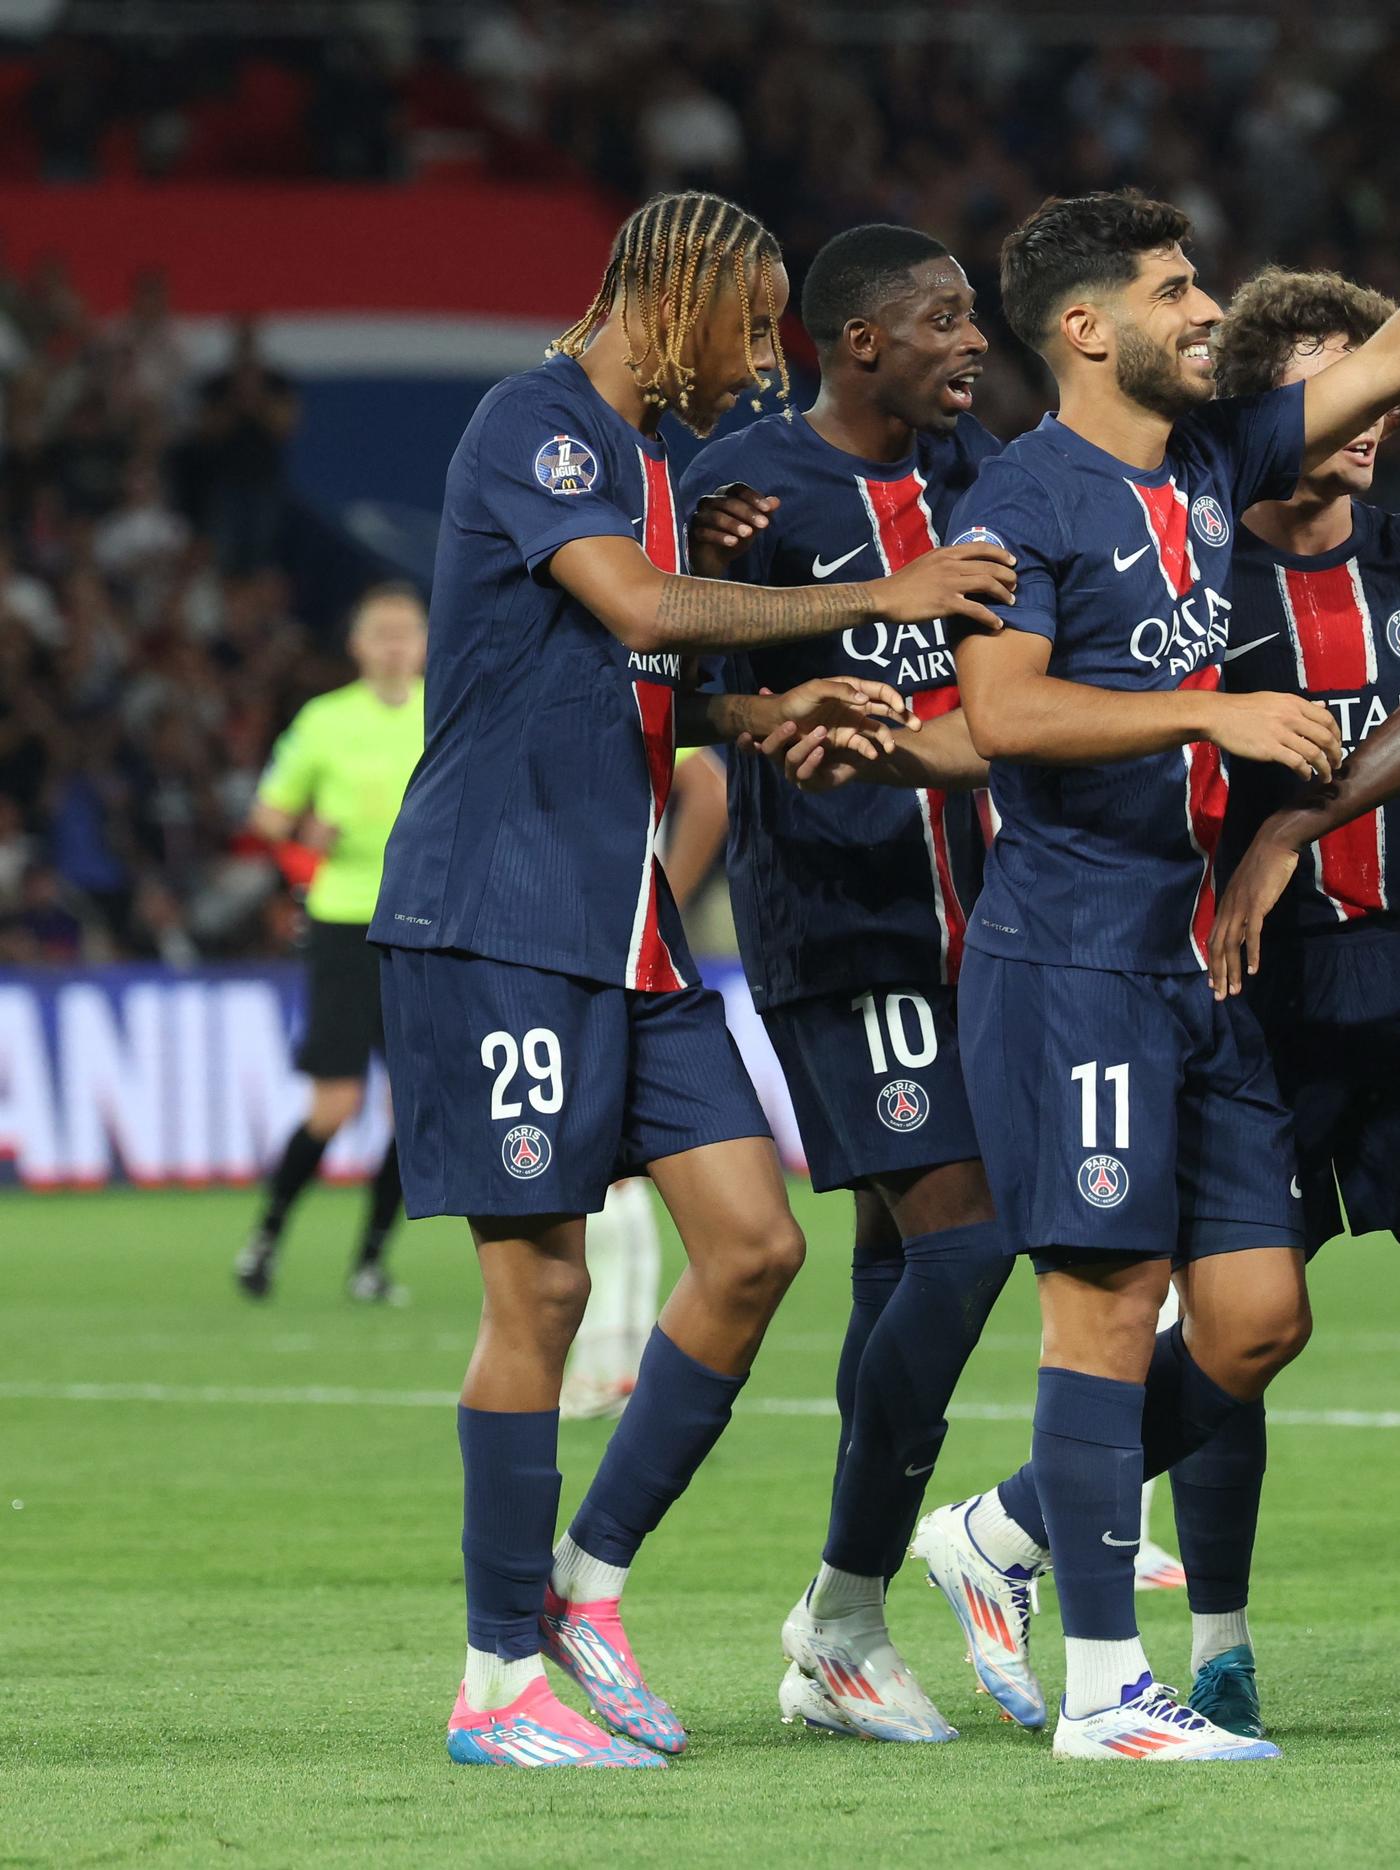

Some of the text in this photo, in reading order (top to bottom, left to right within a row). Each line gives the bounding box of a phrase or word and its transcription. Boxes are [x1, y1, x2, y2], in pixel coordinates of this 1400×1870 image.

[1193, 499, 1214, 515] PARIS
[851, 988, 938, 1074] 10
[481, 1028, 563, 1120] 29
[882, 1082, 916, 1098] PARIS
[1071, 1061, 1129, 1149] 11
[508, 1128, 541, 1143] PARIS
[1085, 1158, 1119, 1171] PARIS
[480, 1724, 538, 1744] F50
